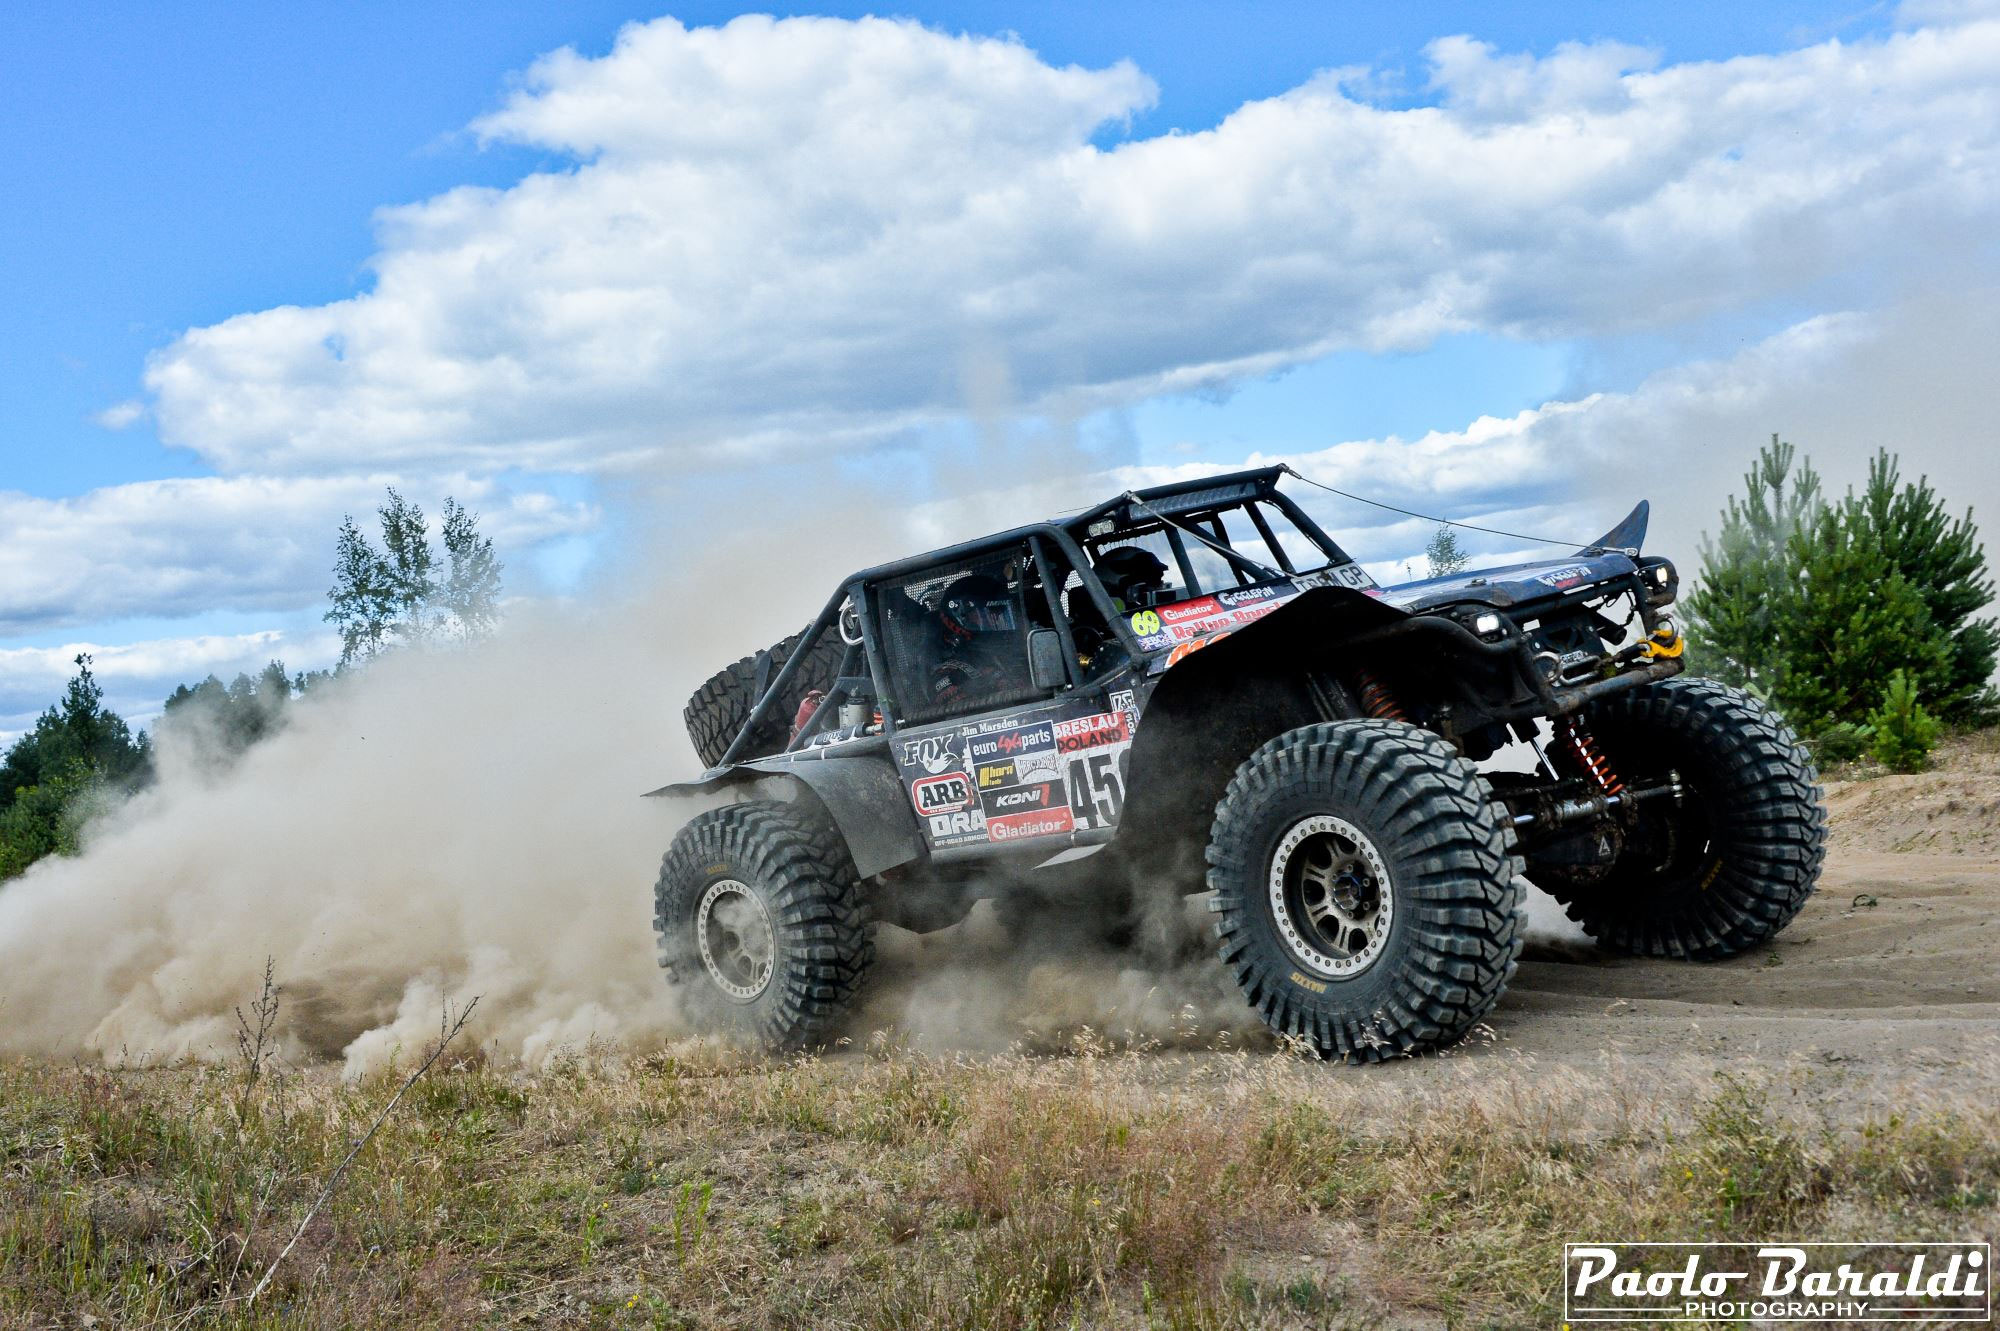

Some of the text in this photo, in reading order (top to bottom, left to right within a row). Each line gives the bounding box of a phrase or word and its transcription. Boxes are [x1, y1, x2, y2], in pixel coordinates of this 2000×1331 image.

[1131, 610, 1161, 636] 69
[1164, 604, 1214, 620] Gladiator
[962, 718, 1018, 737] Jim Marsden
[1053, 713, 1119, 738] BRESLAU
[904, 733, 955, 767] FOX
[921, 781, 967, 808] ARB
[996, 789, 1041, 807] KONI
[1069, 749, 1131, 830] 45
[992, 820, 1066, 840] Gladiator
